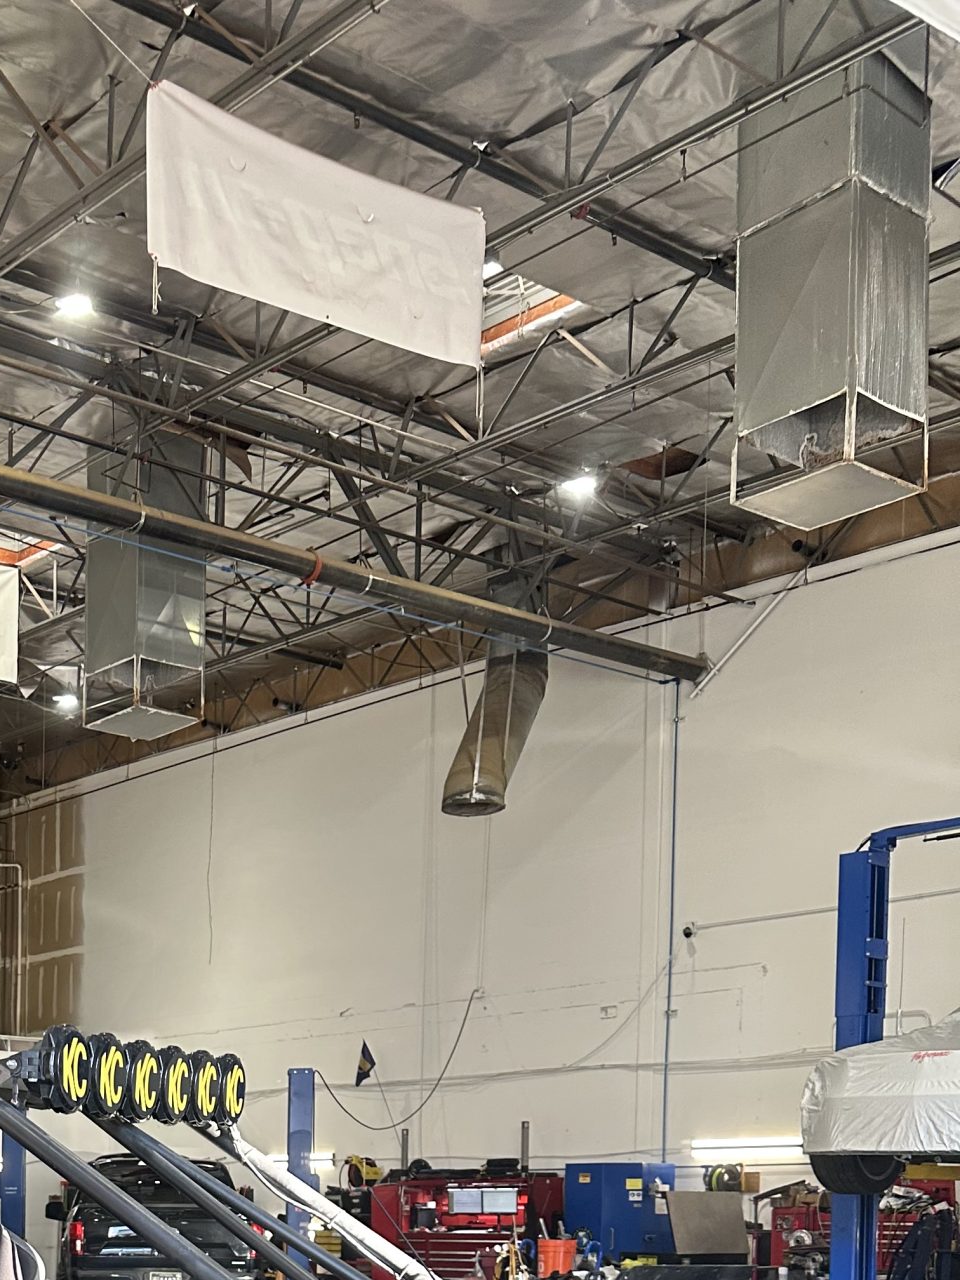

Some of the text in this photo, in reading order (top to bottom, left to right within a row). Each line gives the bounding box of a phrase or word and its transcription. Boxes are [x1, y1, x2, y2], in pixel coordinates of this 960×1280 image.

[63, 1037, 87, 1101] KC
[100, 1046, 123, 1107] KC
[135, 1053, 157, 1111] KC
[169, 1058, 188, 1114] KC
[198, 1062, 217, 1116] KC
[226, 1065, 244, 1117] KC
